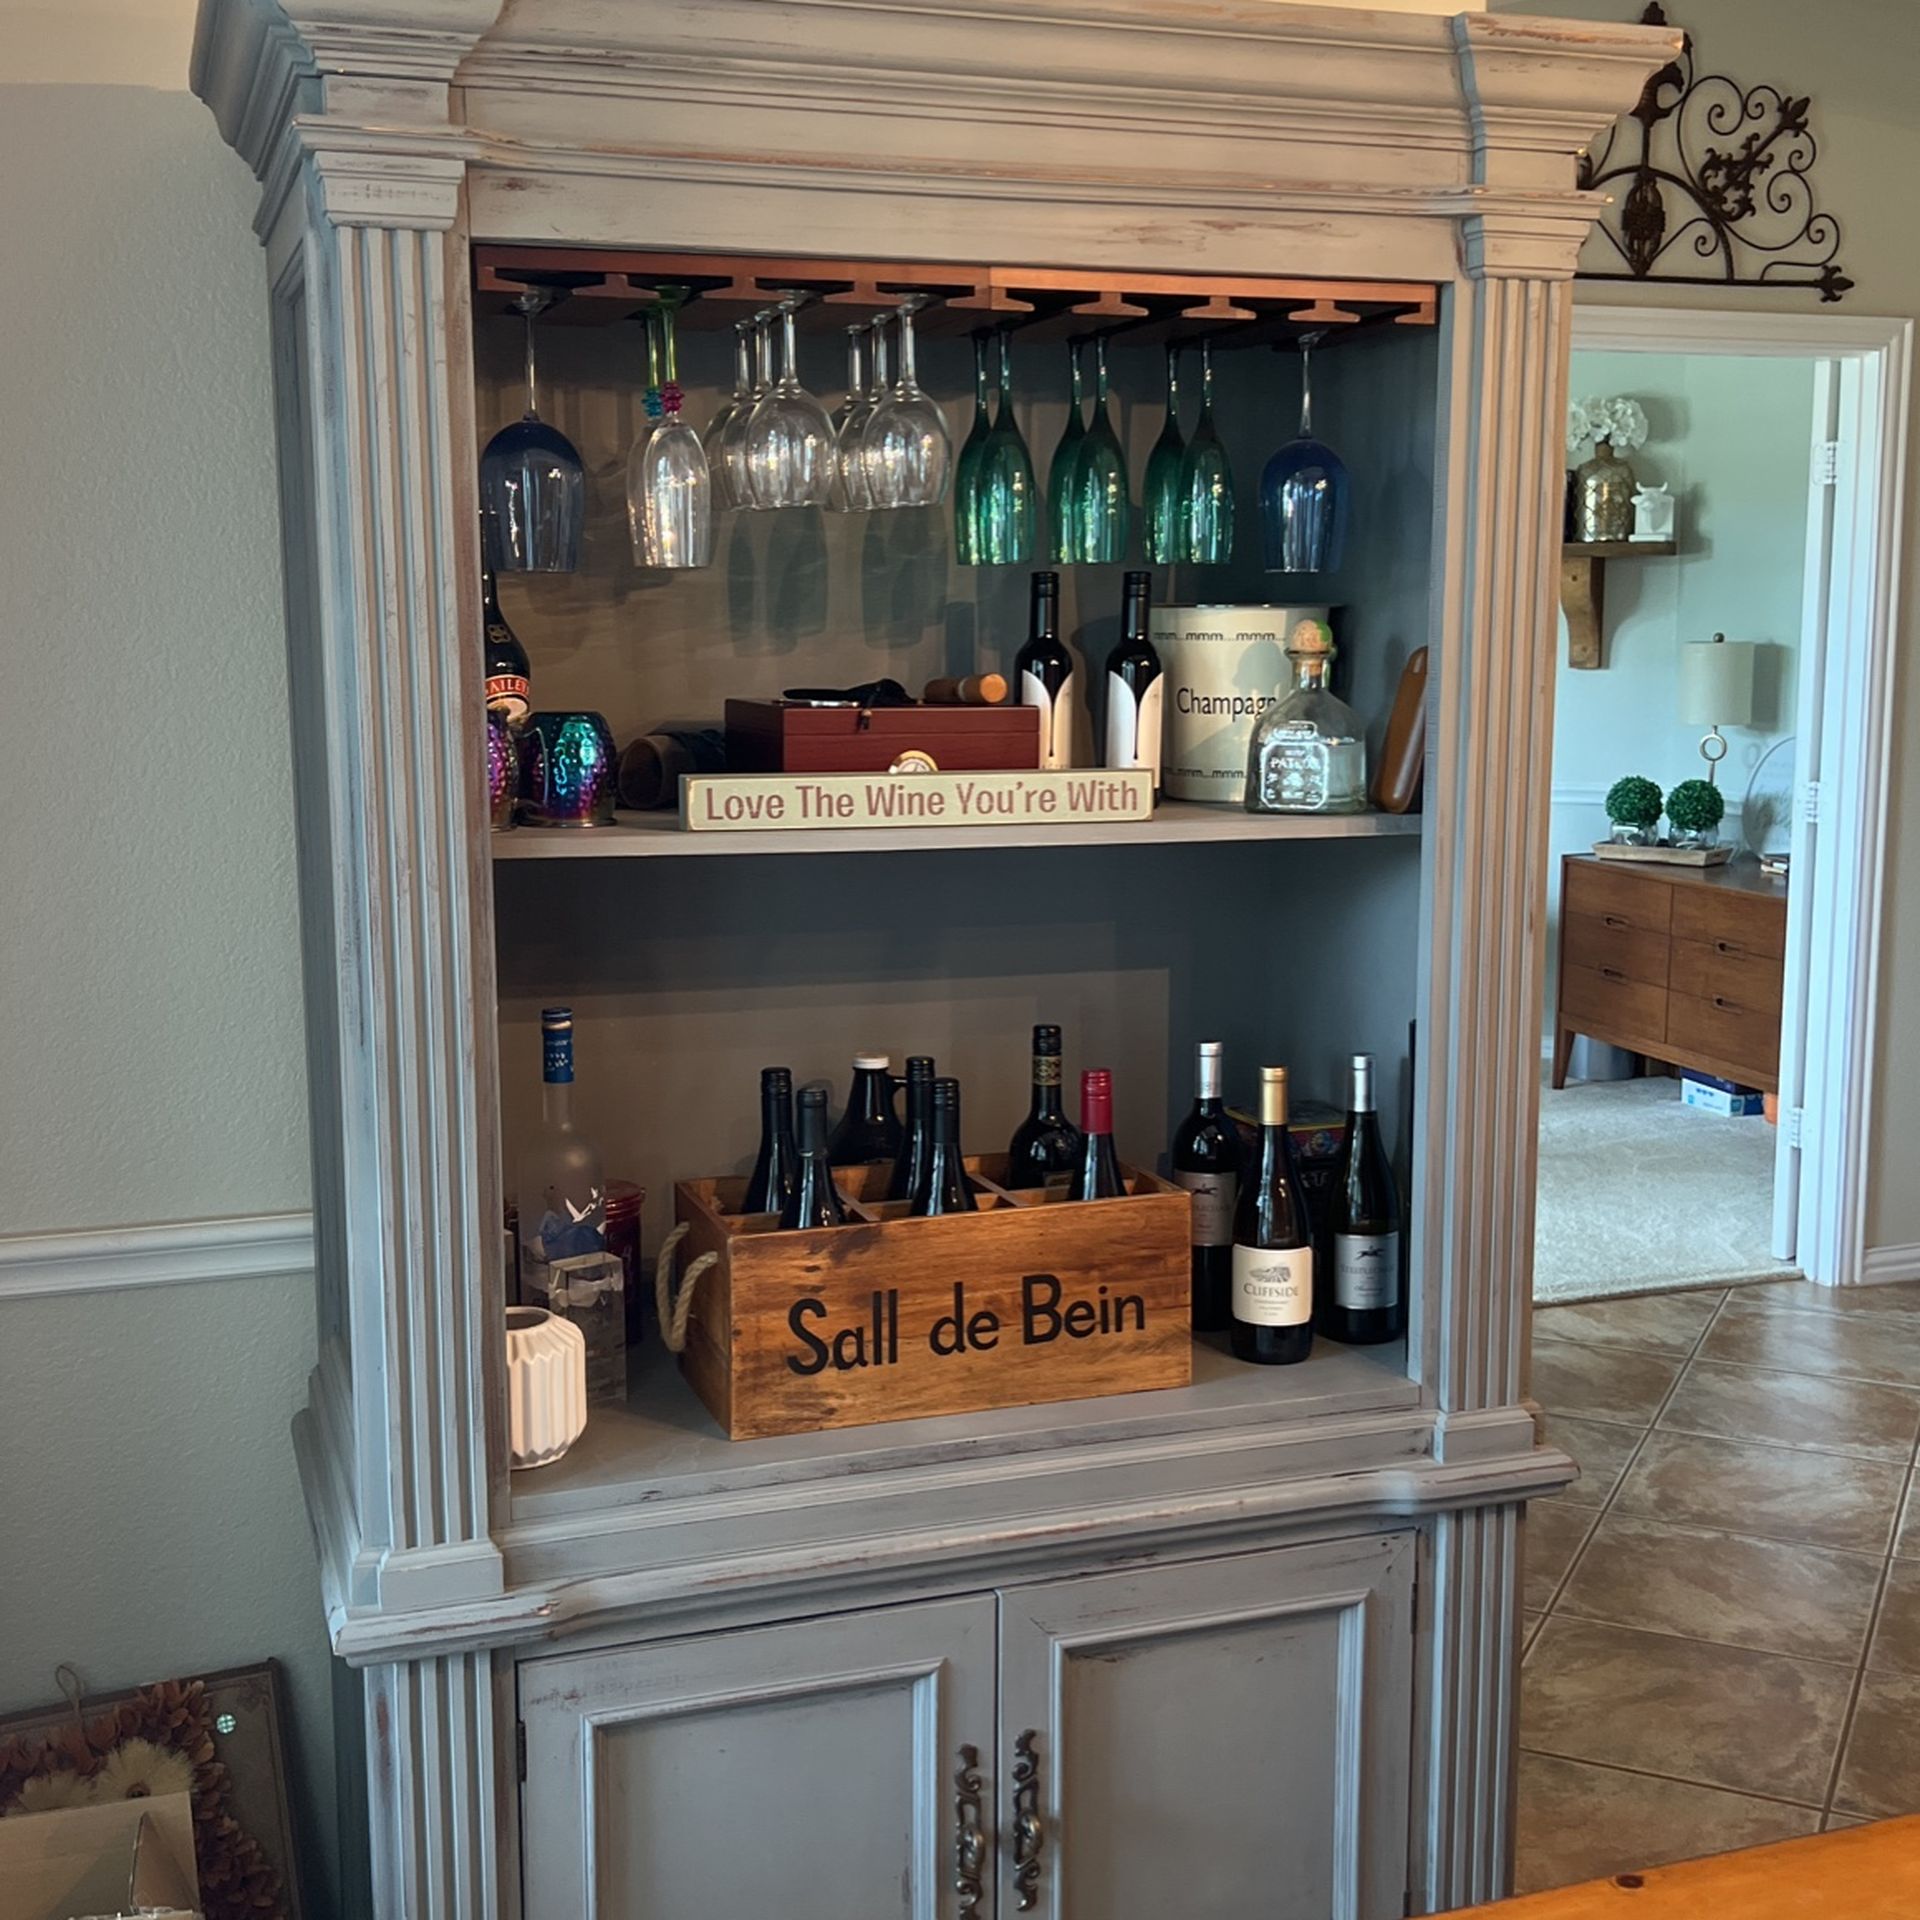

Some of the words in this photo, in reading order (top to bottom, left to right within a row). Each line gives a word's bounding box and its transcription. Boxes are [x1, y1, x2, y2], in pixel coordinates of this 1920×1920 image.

[485, 679, 530, 696] AILEY
[1176, 687, 1277, 722] Champagn
[1270, 756, 1321, 770] PAT
[706, 787, 785, 821] Love
[795, 784, 855, 819] The
[865, 783, 945, 817] Wine
[955, 781, 1057, 815] You're
[1067, 779, 1138, 812] With
[1243, 1282, 1299, 1297] CLIFFSIDE
[785, 1288, 898, 1376] Sall
[928, 1281, 1000, 1356] de
[1022, 1273, 1145, 1345] Bein
